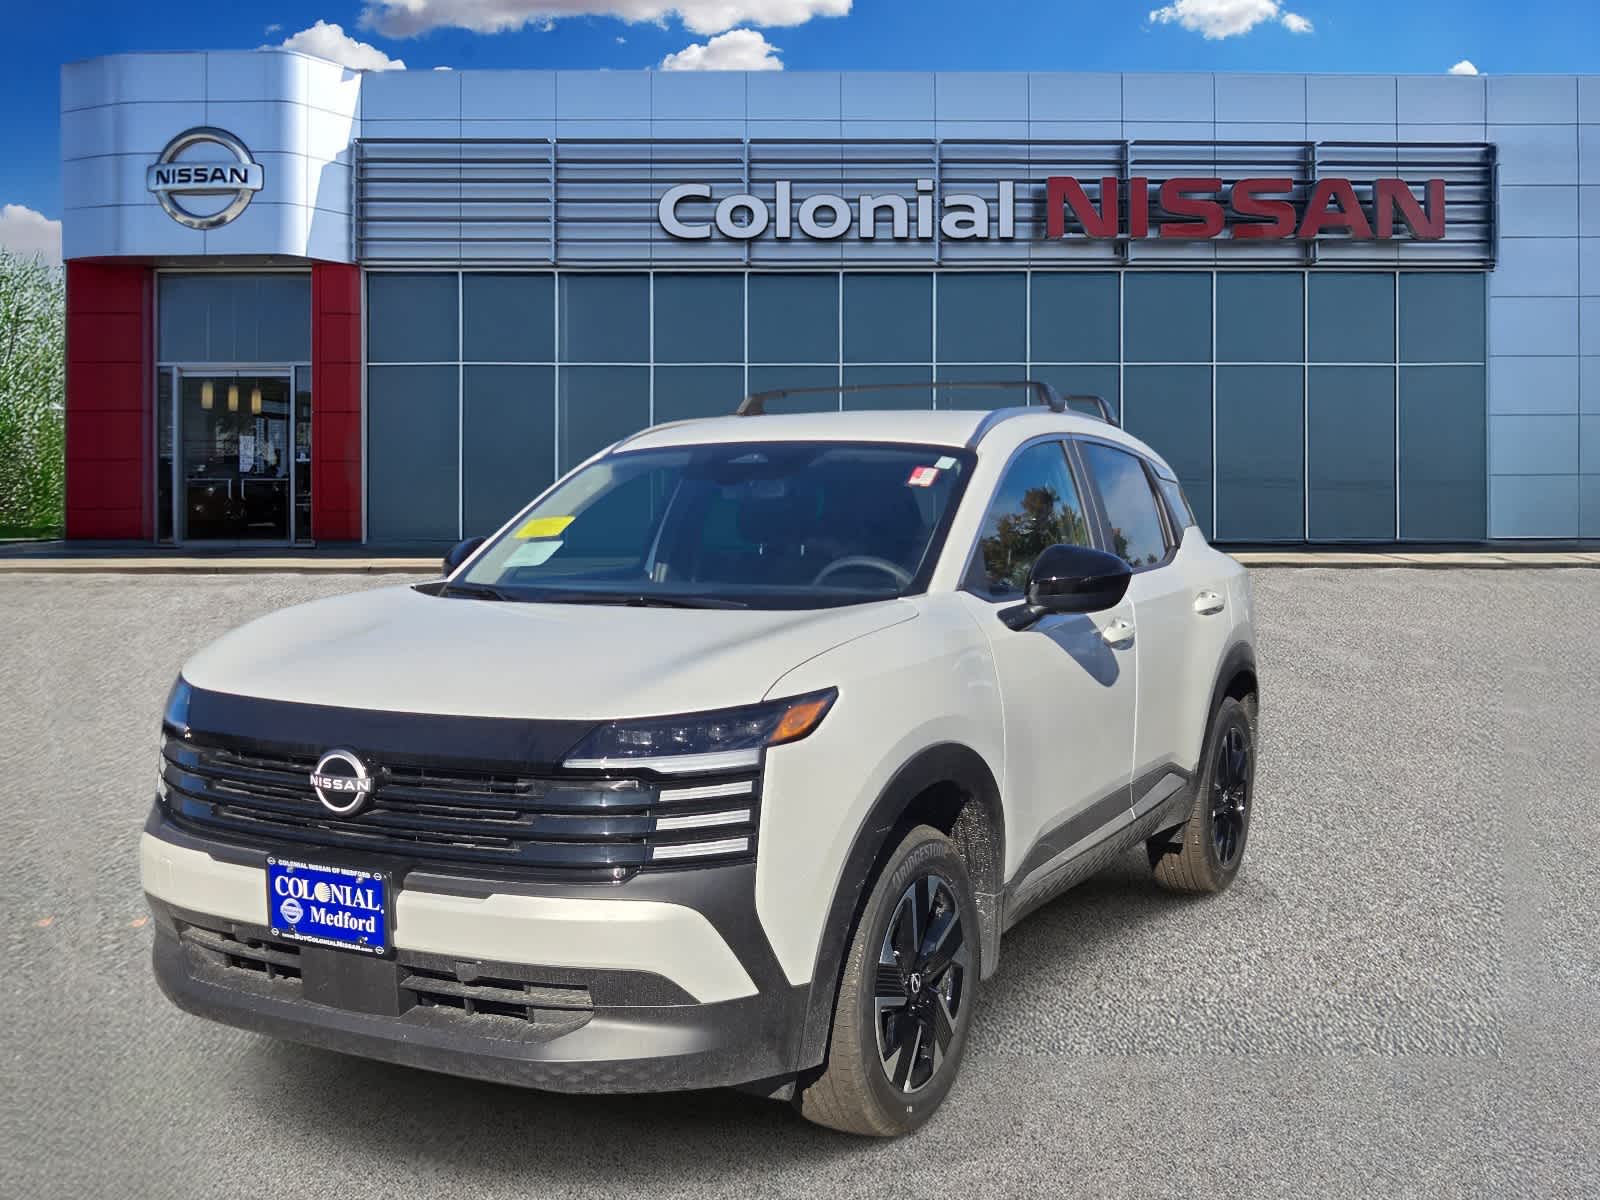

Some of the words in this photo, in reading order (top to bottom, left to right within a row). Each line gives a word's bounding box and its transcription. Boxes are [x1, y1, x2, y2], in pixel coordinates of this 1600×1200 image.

[155, 167, 249, 185] NISSAN
[657, 178, 1015, 241] Colonial
[1045, 175, 1447, 240] NISSAN
[309, 774, 370, 792] NISSAN
[277, 858, 309, 870] COLONIAL
[308, 863, 332, 873] NISSAN
[332, 866, 341, 874] OF
[340, 868, 371, 879] MEDFORD
[274, 875, 381, 911] COLONIAL
[309, 905, 377, 934] Medford
